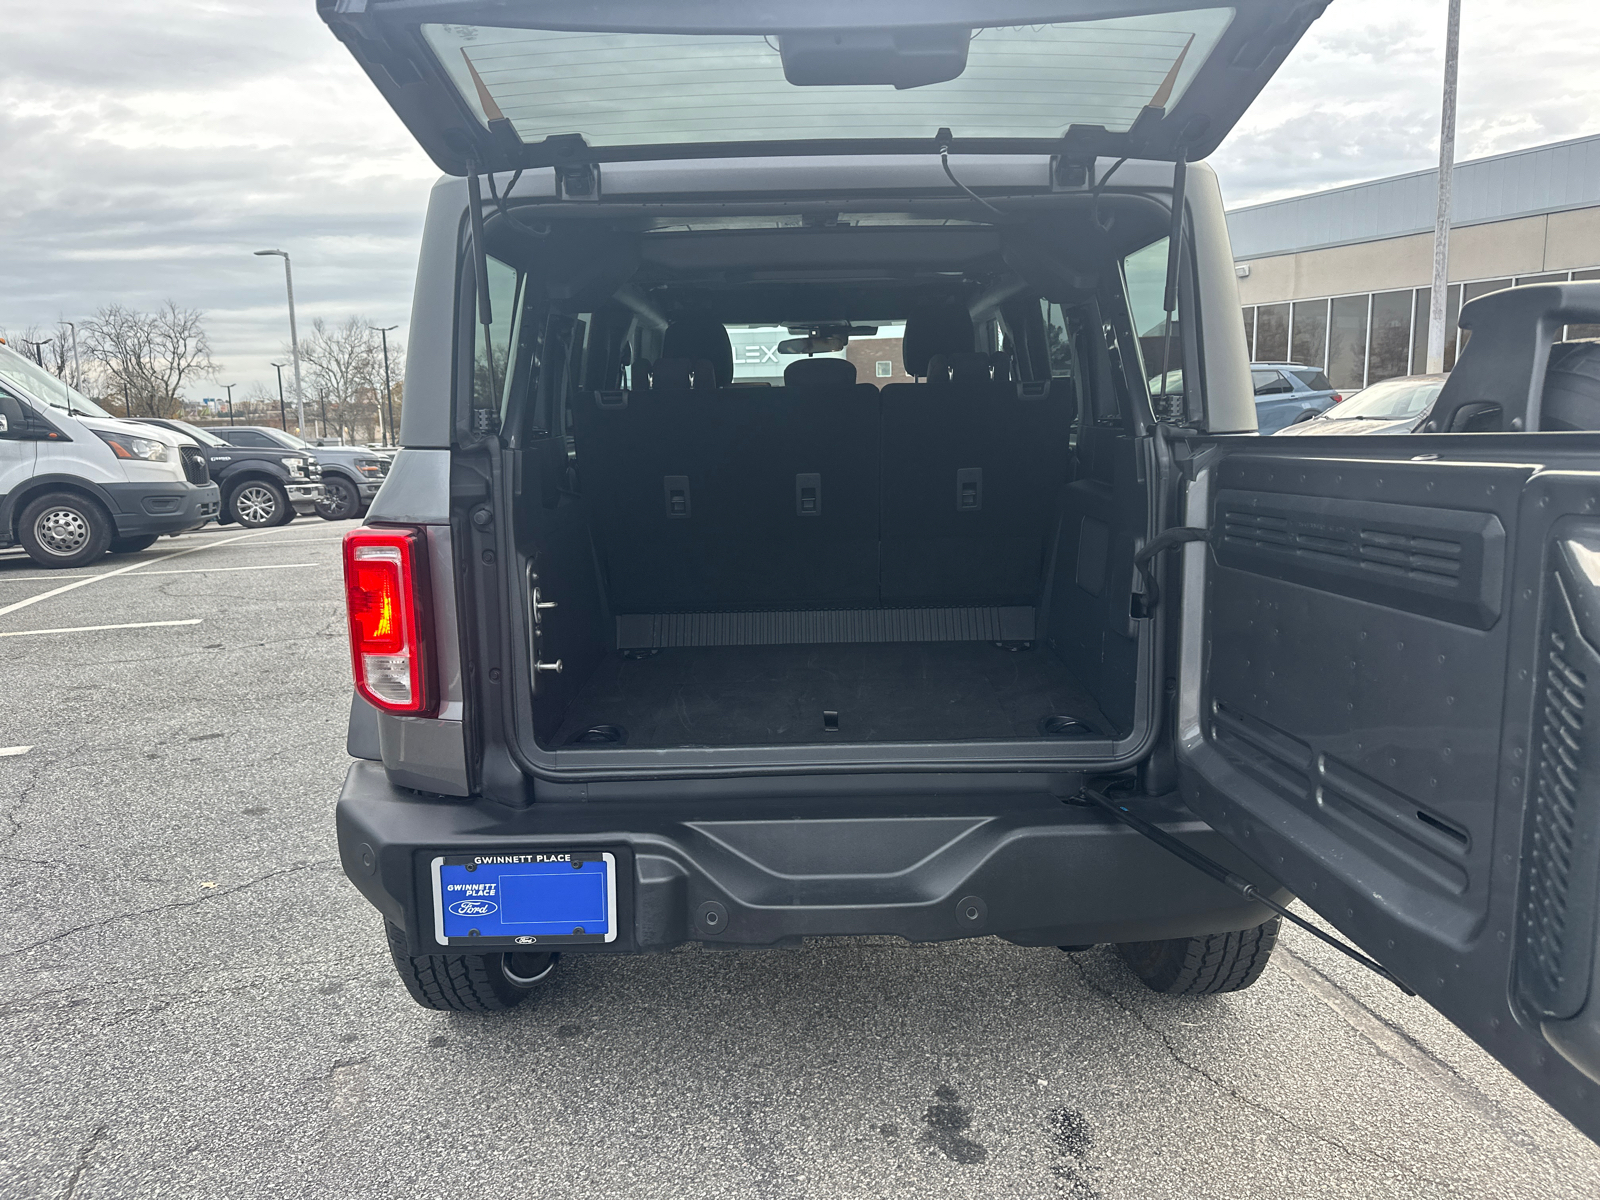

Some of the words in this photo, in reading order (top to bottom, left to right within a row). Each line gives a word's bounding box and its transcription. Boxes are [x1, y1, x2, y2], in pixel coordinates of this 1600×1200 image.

[474, 855, 532, 864] GWINNETT
[536, 854, 571, 862] PLACE
[447, 883, 497, 891] GWINNETT
[465, 889, 496, 897] PLACE
[457, 901, 489, 914] Ford
